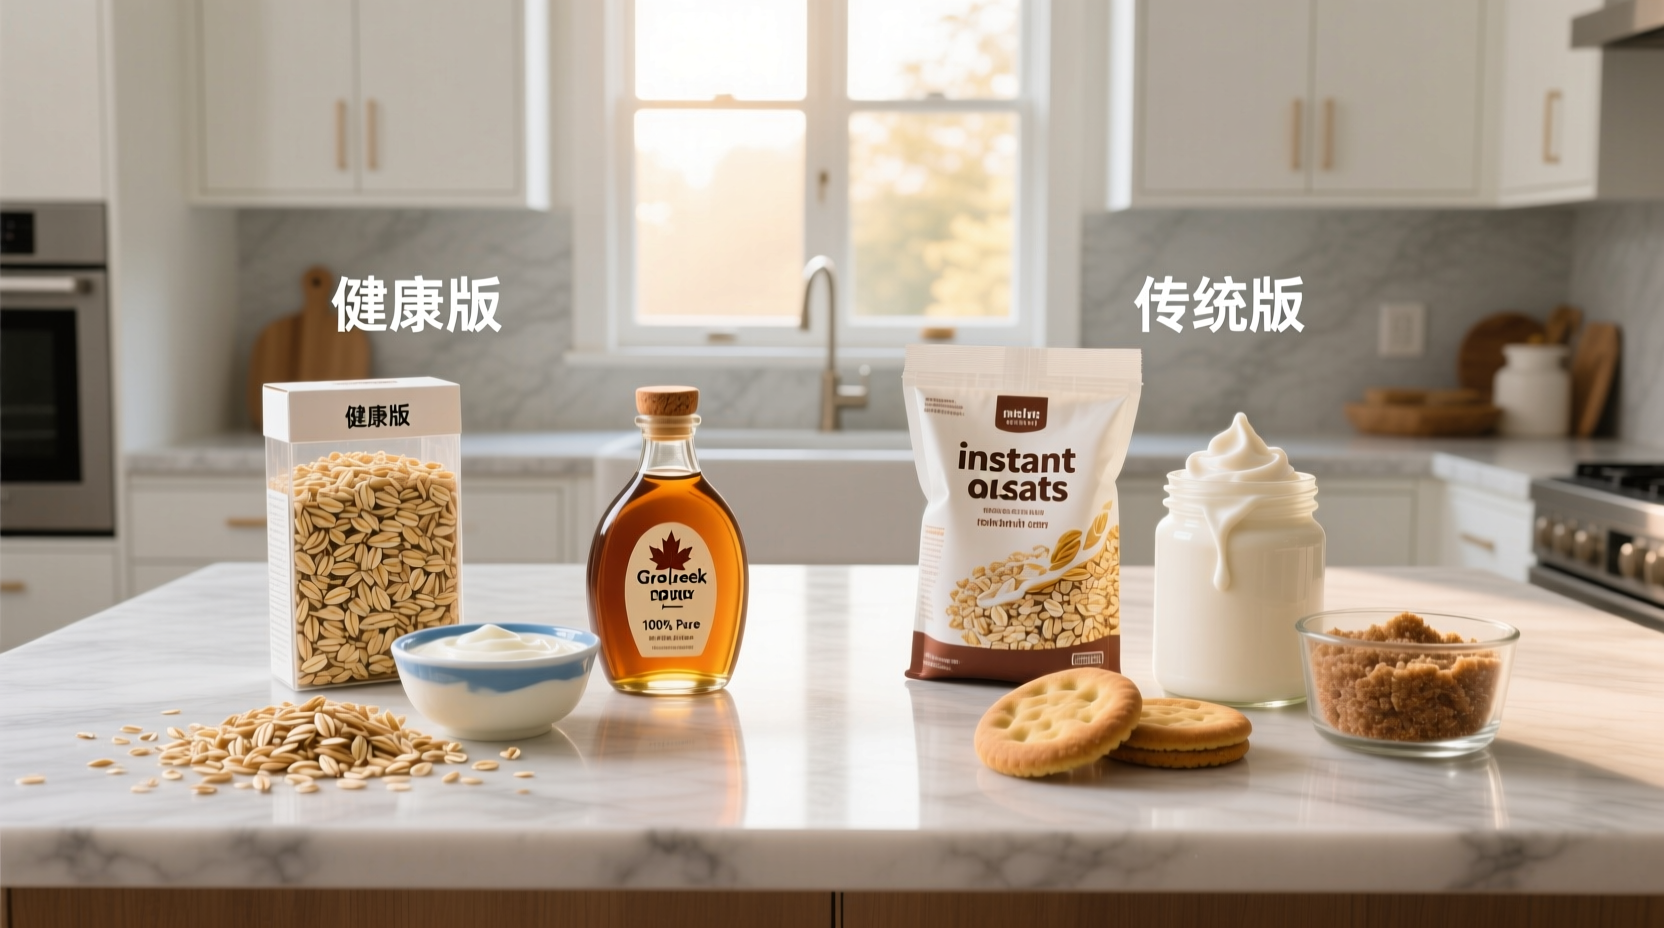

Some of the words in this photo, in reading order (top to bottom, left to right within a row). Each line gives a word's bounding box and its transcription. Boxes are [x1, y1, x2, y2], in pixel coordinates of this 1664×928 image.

[345, 403, 411, 429] 健康版
[958, 441, 1076, 473] instant
[642, 619, 673, 631] 100%
[676, 619, 701, 631] Pure
